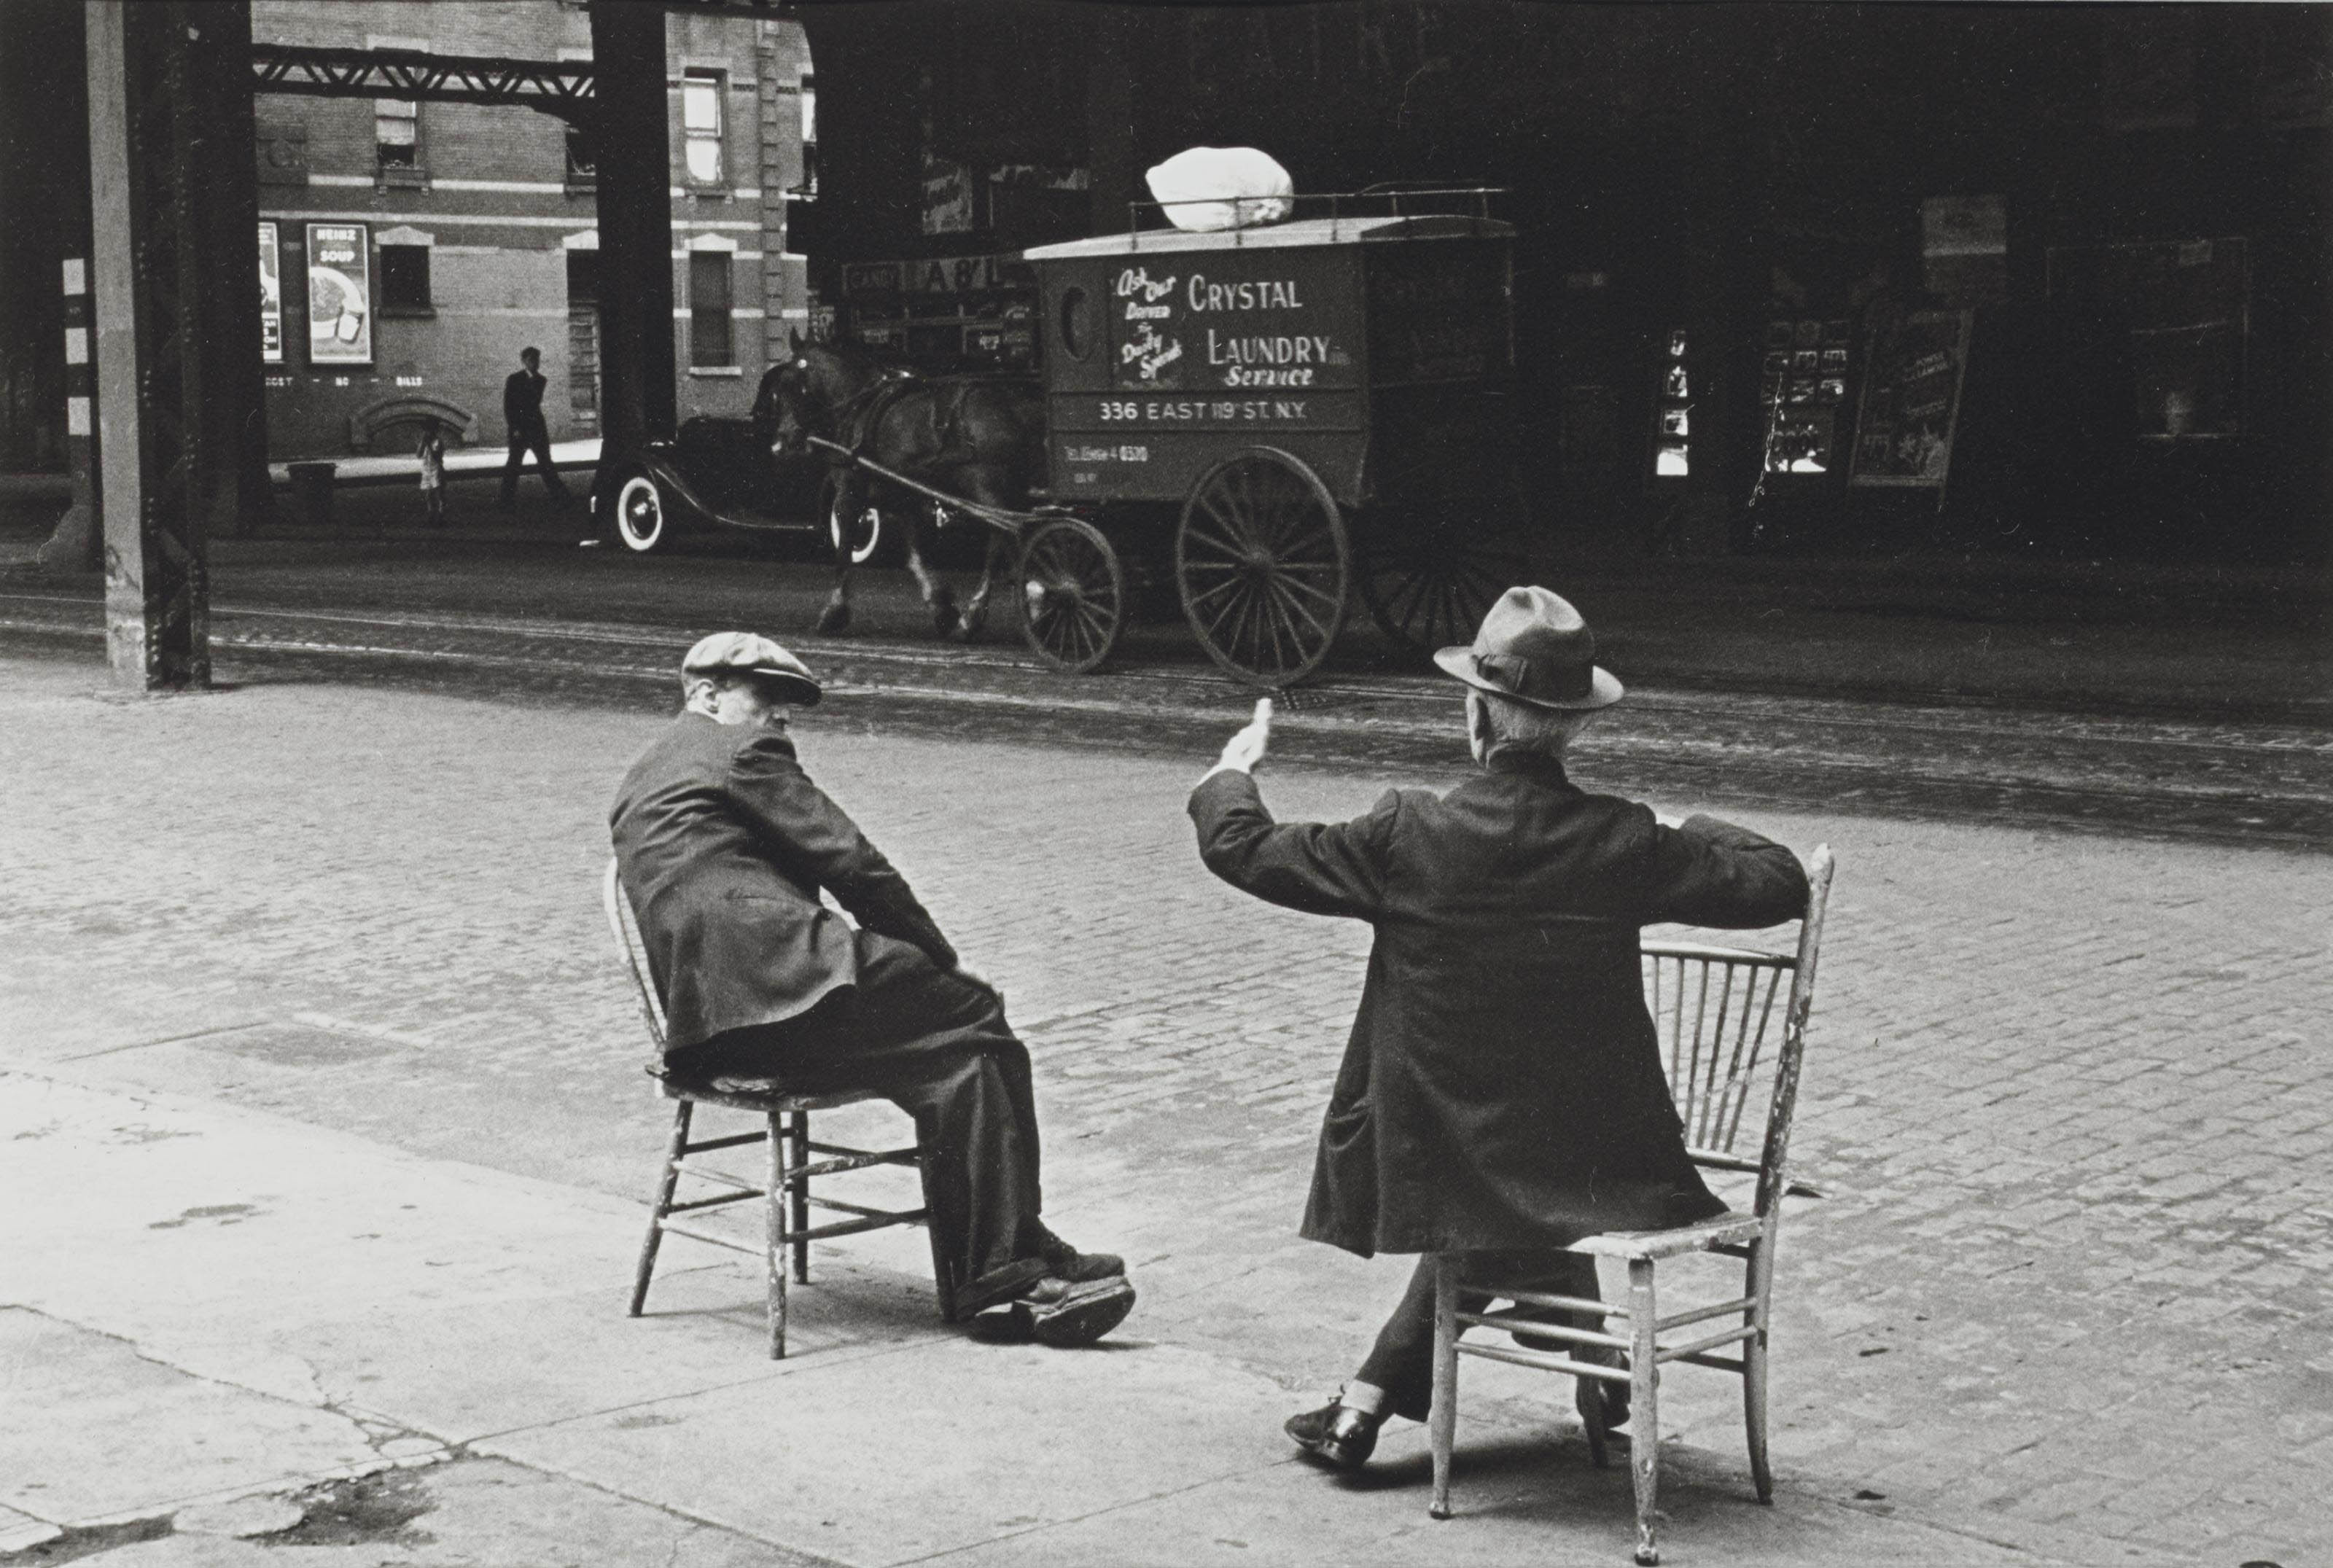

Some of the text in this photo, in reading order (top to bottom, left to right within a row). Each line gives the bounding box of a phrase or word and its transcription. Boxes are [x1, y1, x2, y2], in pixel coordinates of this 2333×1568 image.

[316, 229, 357, 241] HEINZ
[320, 250, 356, 262] SOUP
[1117, 266, 1148, 296] Ask
[1188, 274, 1304, 312] CRYSTAL
[1207, 329, 1331, 365] LAUNDRY
[335, 376, 349, 387] NO
[396, 376, 422, 387] BILLS
[1223, 366, 1314, 387] Service
[1099, 402, 1139, 421] 336
[1146, 402, 1207, 420] EAST
